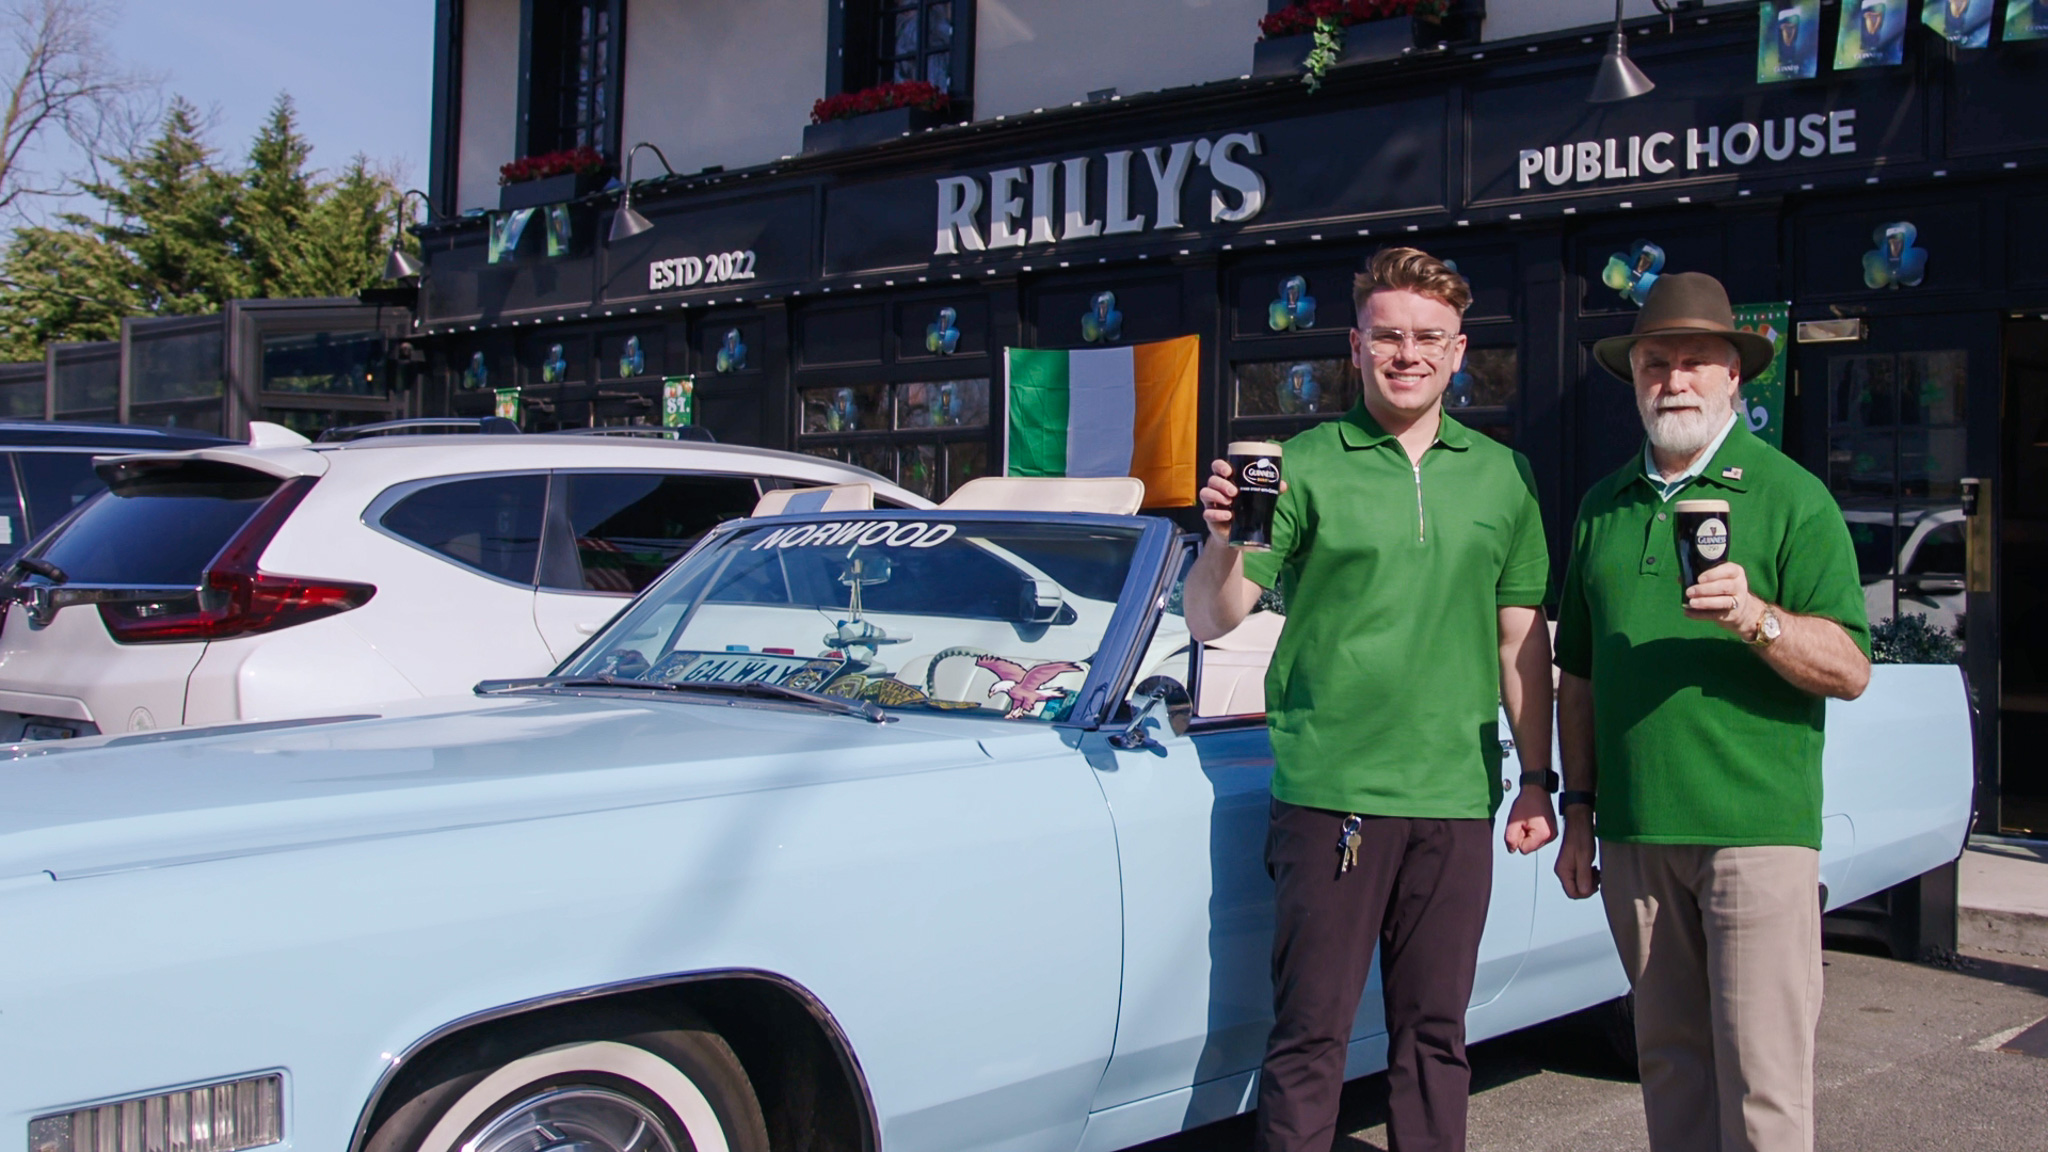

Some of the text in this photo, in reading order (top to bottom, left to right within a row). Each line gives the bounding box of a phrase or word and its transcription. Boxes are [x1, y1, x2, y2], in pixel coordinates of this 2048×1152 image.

[1519, 109, 1857, 189] PUBLIC HOUSE
[934, 131, 1266, 255] REILLY'S
[649, 250, 756, 290] ESTD 2022
[751, 521, 957, 551] NORWOOD
[683, 659, 792, 687] GALWAY
[882, 680, 917, 699] STATE
